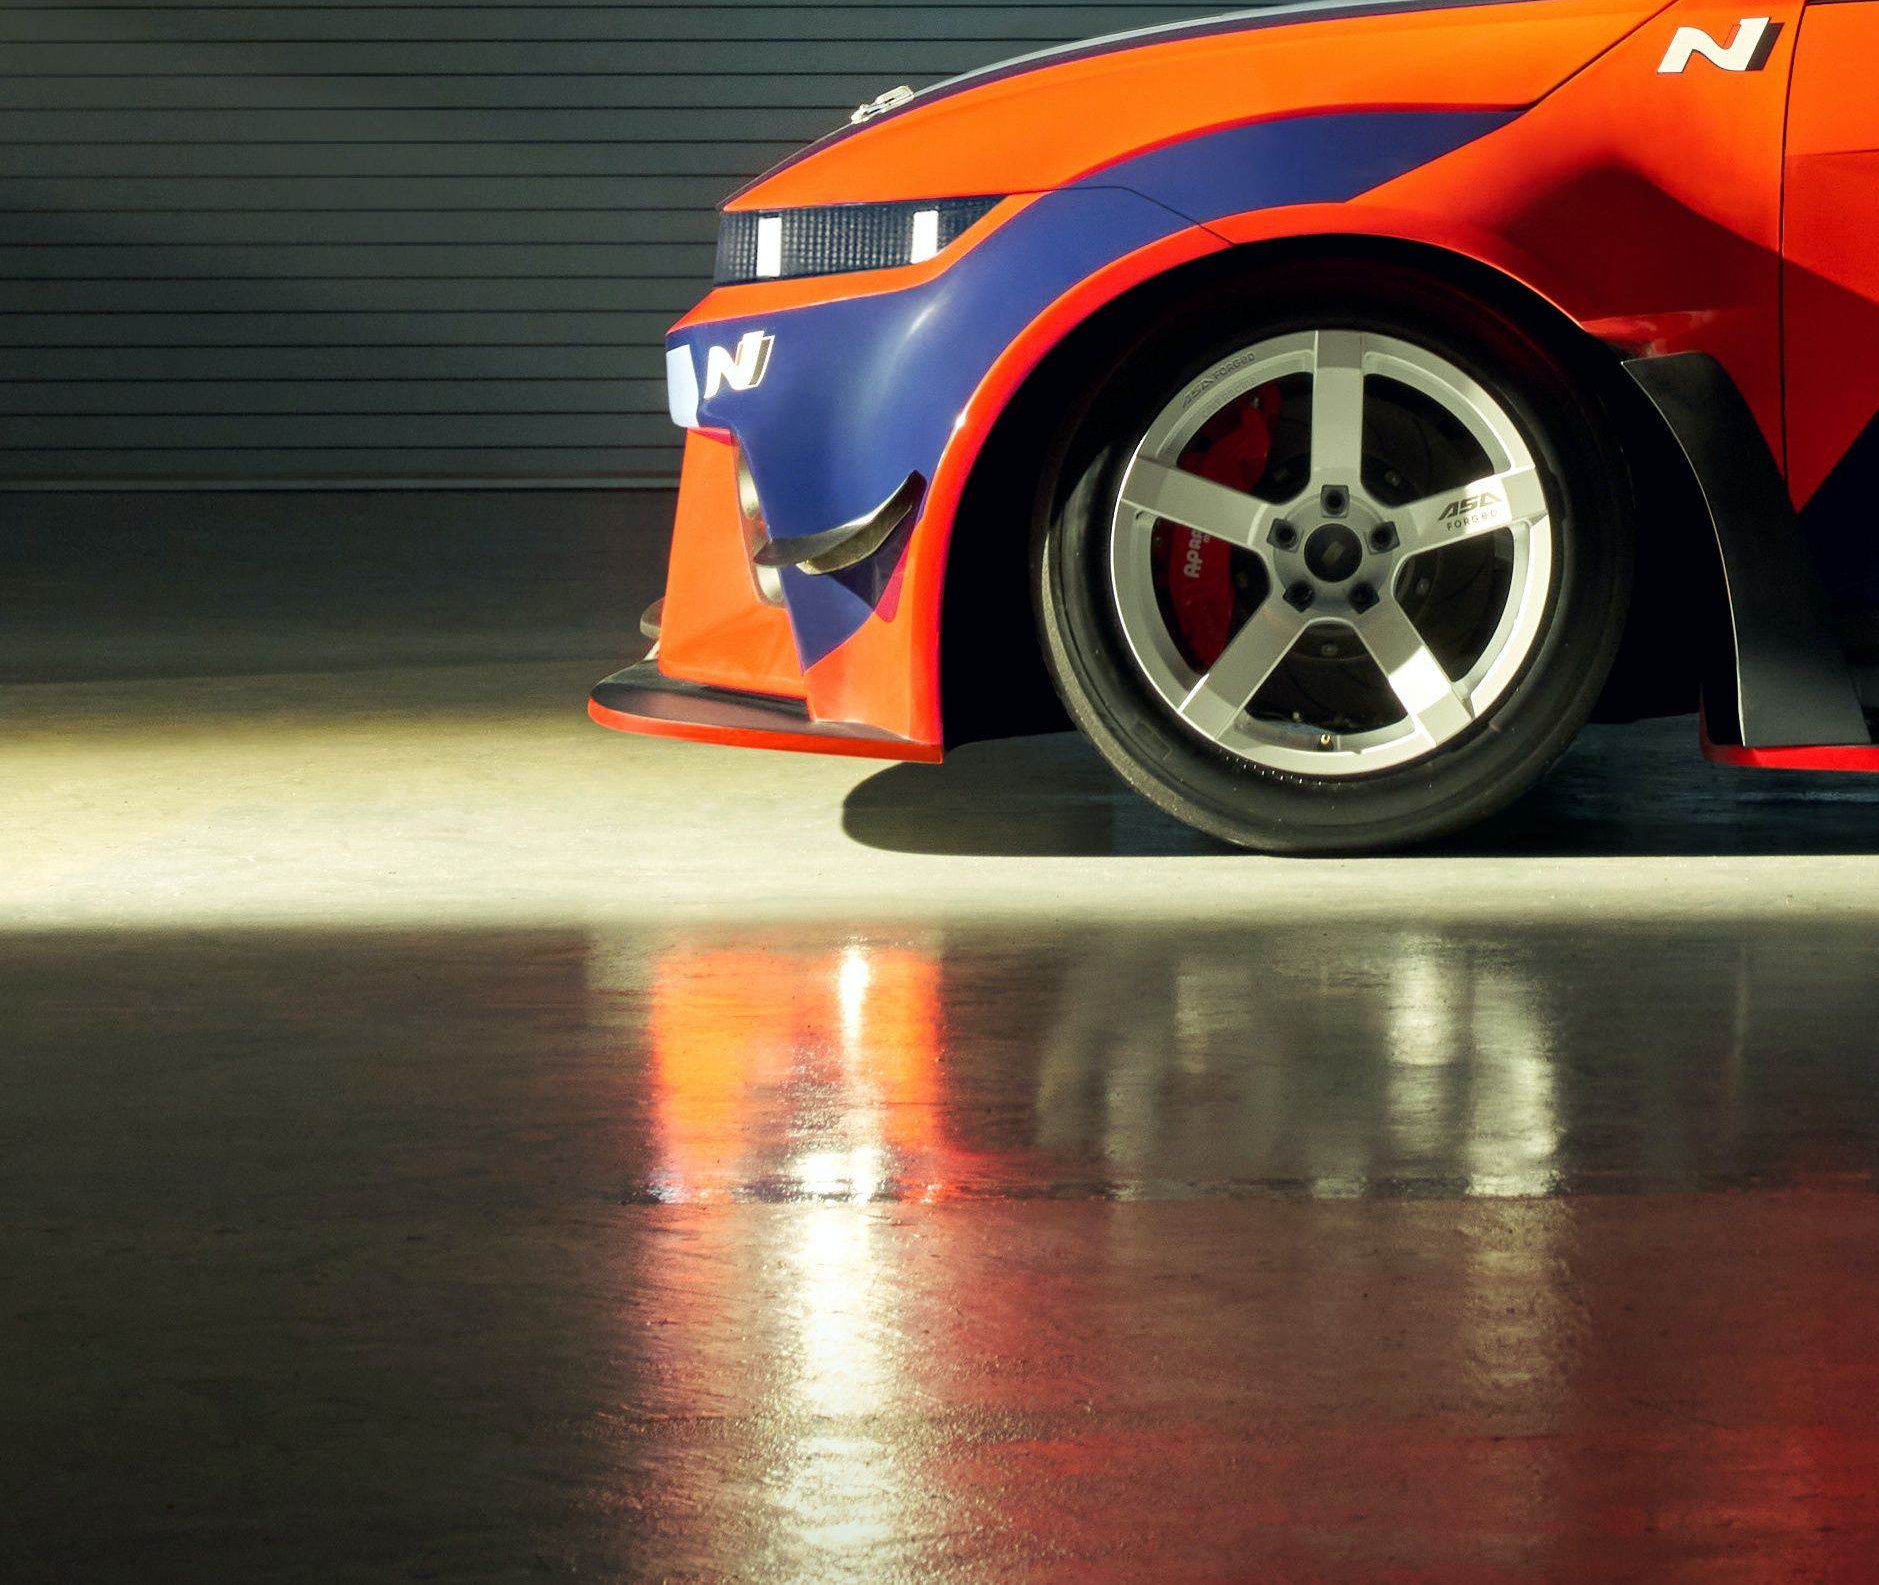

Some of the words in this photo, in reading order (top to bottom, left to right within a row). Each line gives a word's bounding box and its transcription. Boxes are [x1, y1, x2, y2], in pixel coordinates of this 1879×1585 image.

[1656, 17, 1785, 74] N
[703, 330, 775, 399] N
[1437, 492, 1502, 521] ASA
